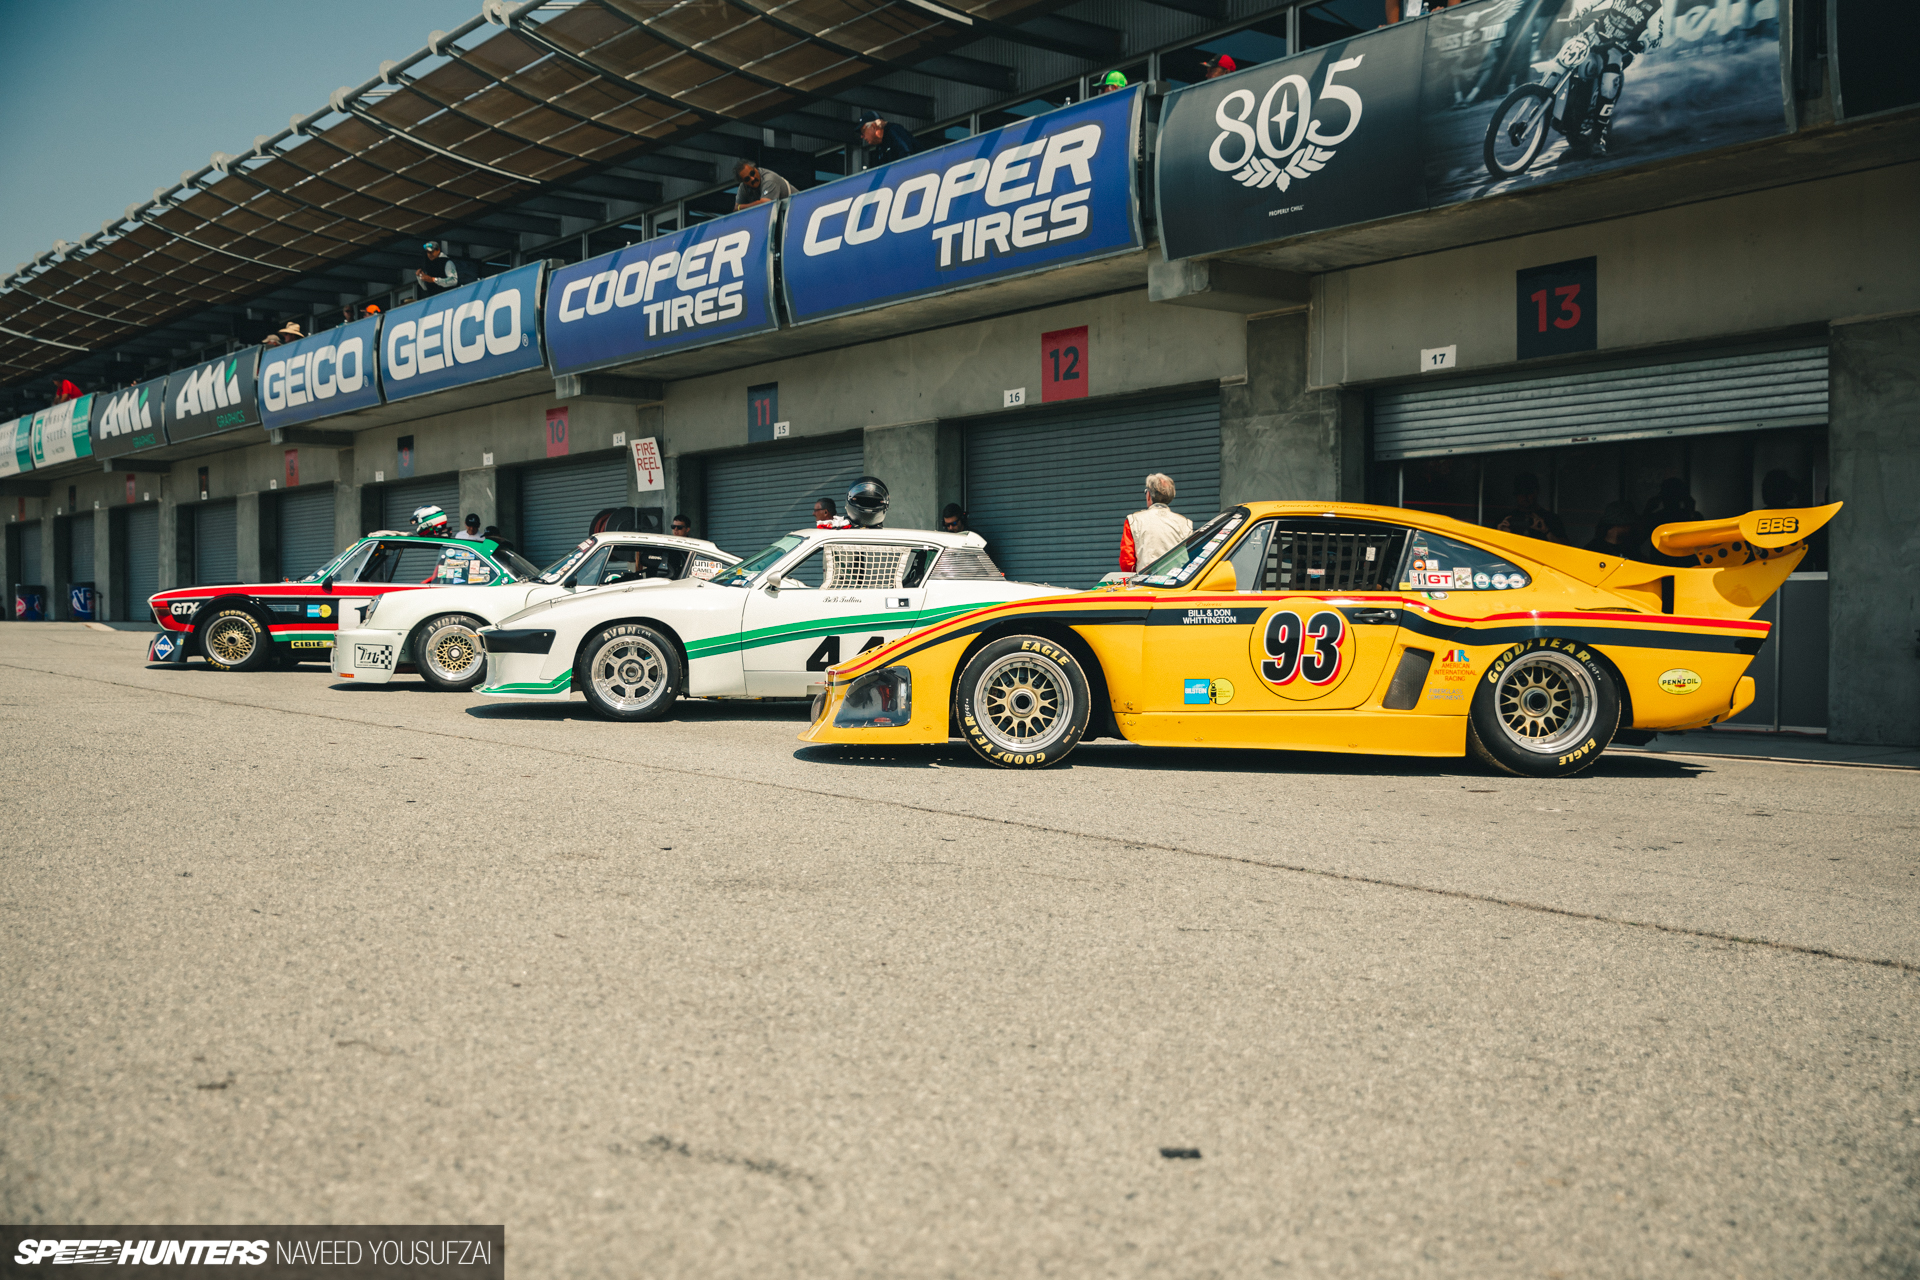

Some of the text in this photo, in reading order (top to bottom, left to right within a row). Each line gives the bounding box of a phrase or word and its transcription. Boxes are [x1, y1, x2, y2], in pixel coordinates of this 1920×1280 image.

[1209, 53, 1365, 172] 805
[803, 124, 1102, 257] COOPER
[931, 187, 1091, 267] TIRES
[558, 230, 750, 323] COOPER
[643, 280, 744, 337] TIRES
[1530, 283, 1581, 333] 13
[387, 288, 521, 381] GEICO
[1049, 346, 1080, 382] 12
[1431, 353, 1446, 365] 17
[263, 336, 364, 412] GEICO
[1009, 392, 1020, 403] 16
[216, 410, 246, 428] GRAPHICS
[754, 398, 770, 426] 11
[549, 419, 565, 444] 10
[778, 425, 787, 435] 15
[402, 447, 409, 467] 9
[635, 441, 656, 457] FIRE
[636, 456, 660, 472] REEL
[1756, 517, 1799, 535] BBS
[1427, 574, 1452, 585] GT
[170, 602, 200, 615] GTX
[1182, 616, 1237, 624] WHITTINGTON
[1187, 608, 1231, 617] BILL & DON
[428, 616, 459, 634] AVON
[602, 626, 636, 642] AVON
[806, 635, 885, 672] 4
[1020, 640, 1070, 666] EAGLE
[1260, 610, 1345, 686] 93
[1487, 638, 1591, 684] GOODYEAR
[1662, 678, 1699, 686] PENNZOIL
[964, 715, 1046, 765] GOODYEAR
[1558, 737, 1597, 766] EAGLE
